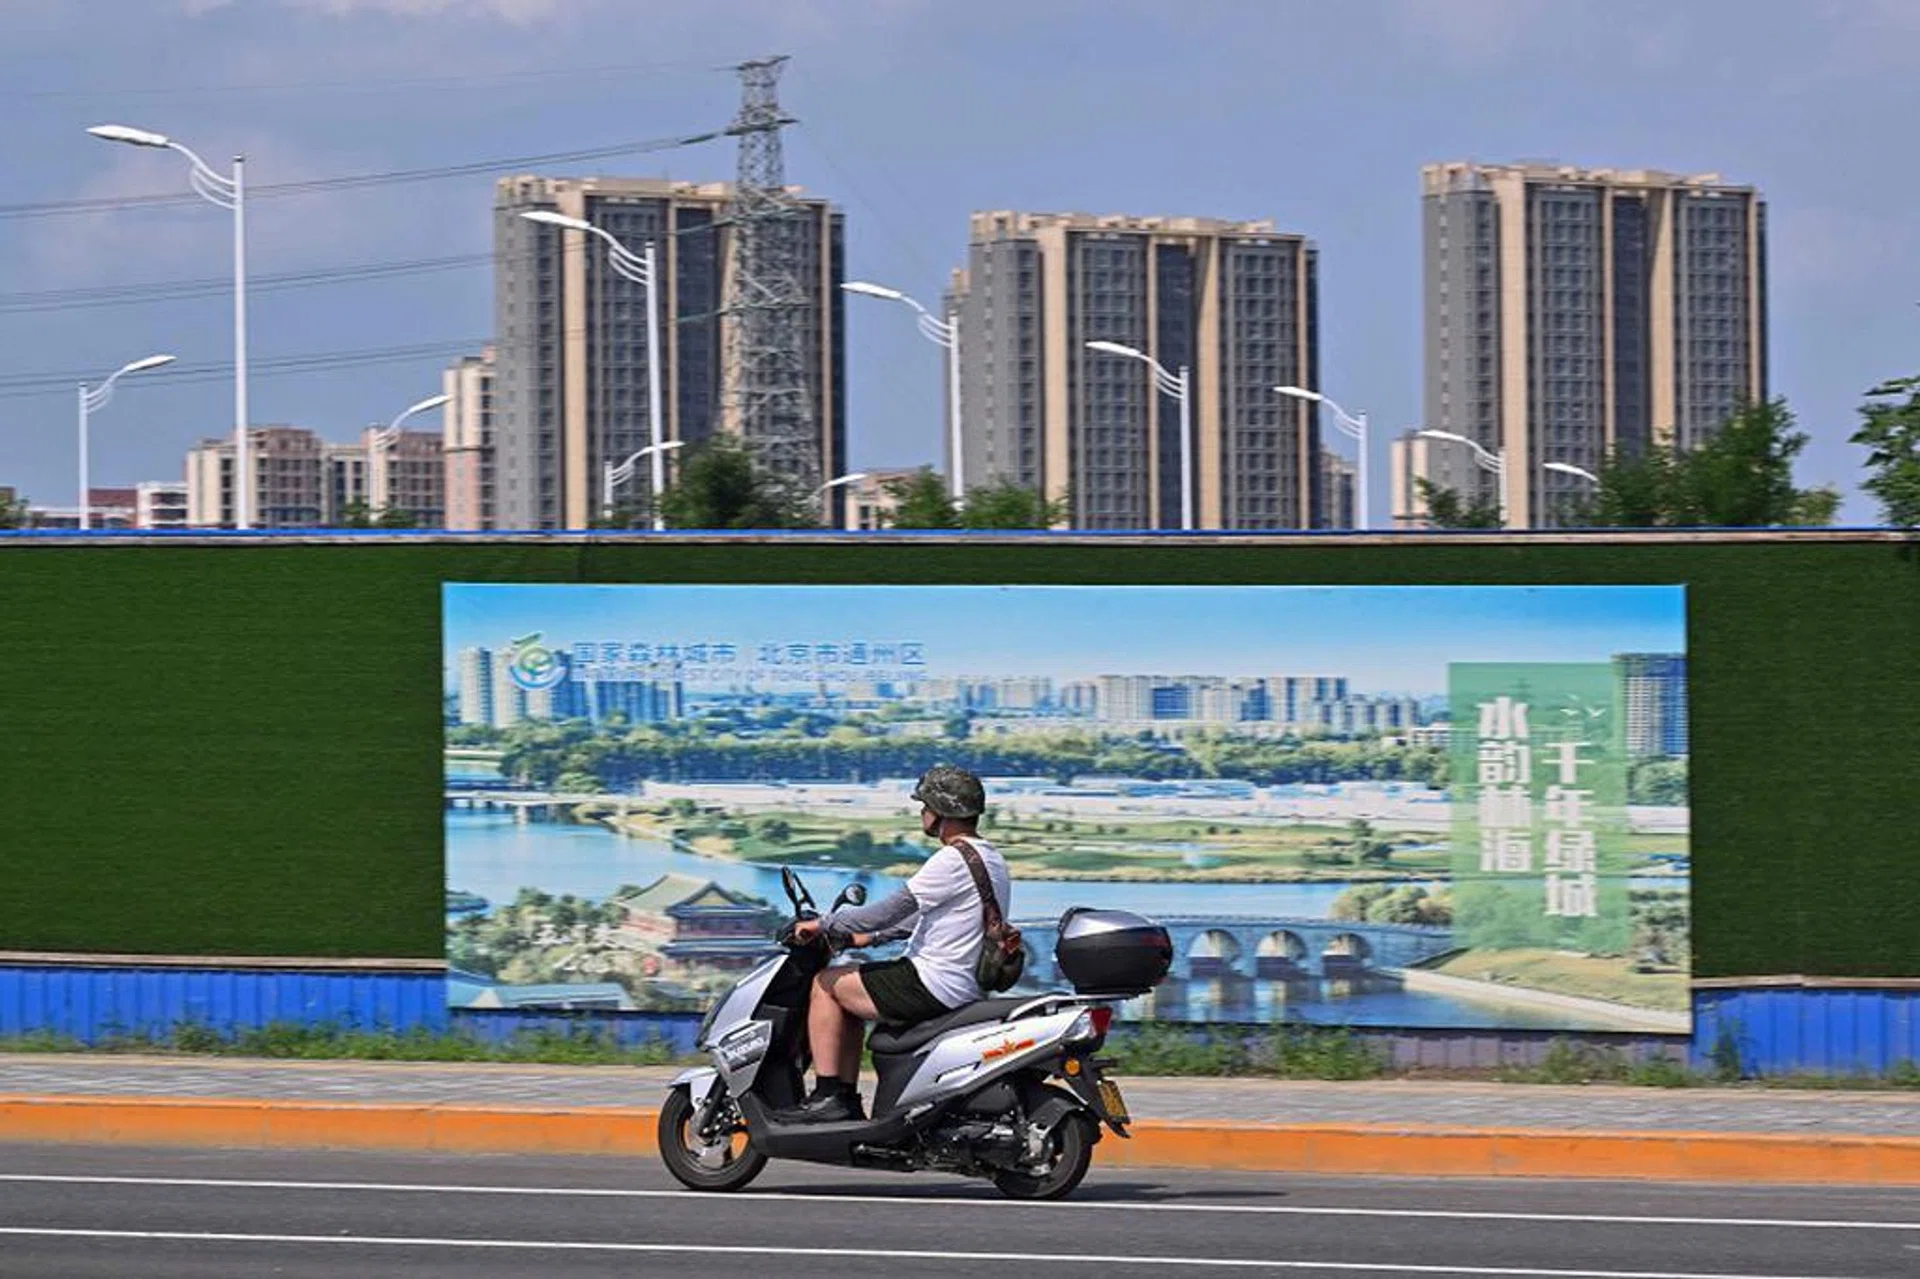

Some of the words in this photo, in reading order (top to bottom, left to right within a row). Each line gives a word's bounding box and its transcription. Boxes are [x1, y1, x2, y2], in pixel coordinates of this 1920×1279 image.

[758, 640, 926, 665] 北京市通州区
[1476, 696, 1531, 872] 水韵林海
[1541, 740, 1598, 917] 千年绿城
